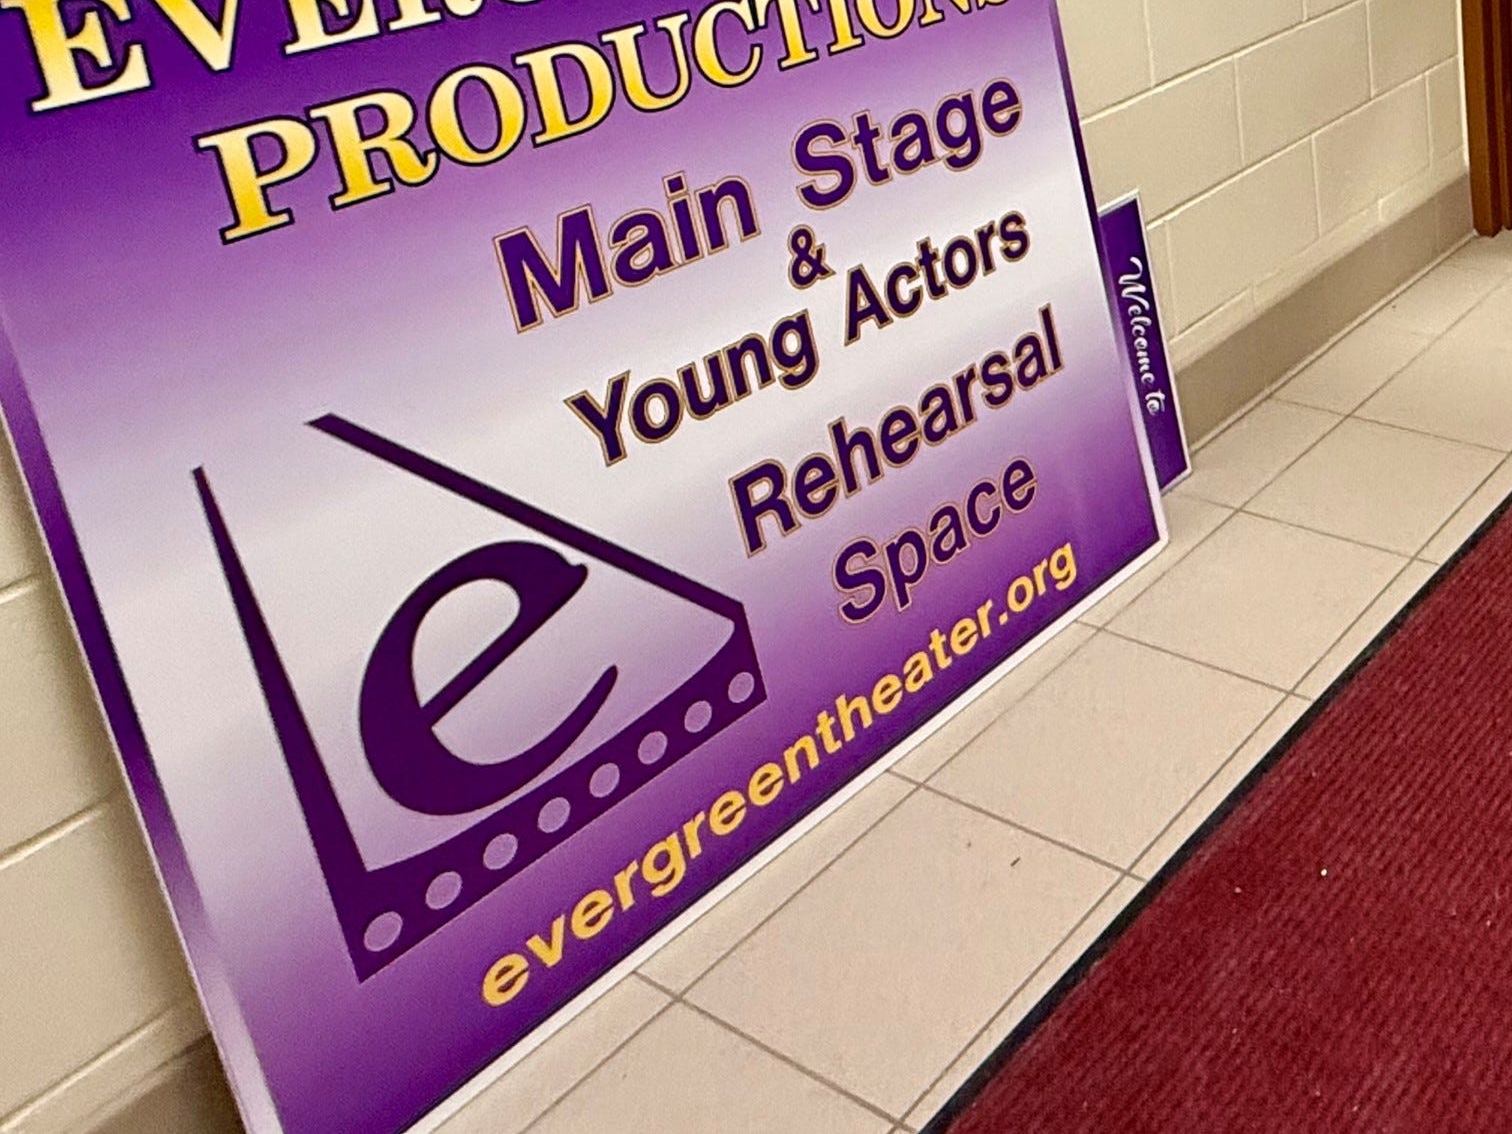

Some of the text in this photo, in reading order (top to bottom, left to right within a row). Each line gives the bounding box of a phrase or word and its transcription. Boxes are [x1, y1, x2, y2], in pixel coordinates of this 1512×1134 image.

[493, 76, 1022, 334] Main Stage
[787, 223, 836, 288] &
[563, 210, 1031, 466] Young Actors
[728, 303, 1065, 557] Rehearsal
[1117, 256, 1167, 416] Welcome to
[830, 456, 1038, 626] Space
[481, 538, 1079, 1007] evergreentheater.org
